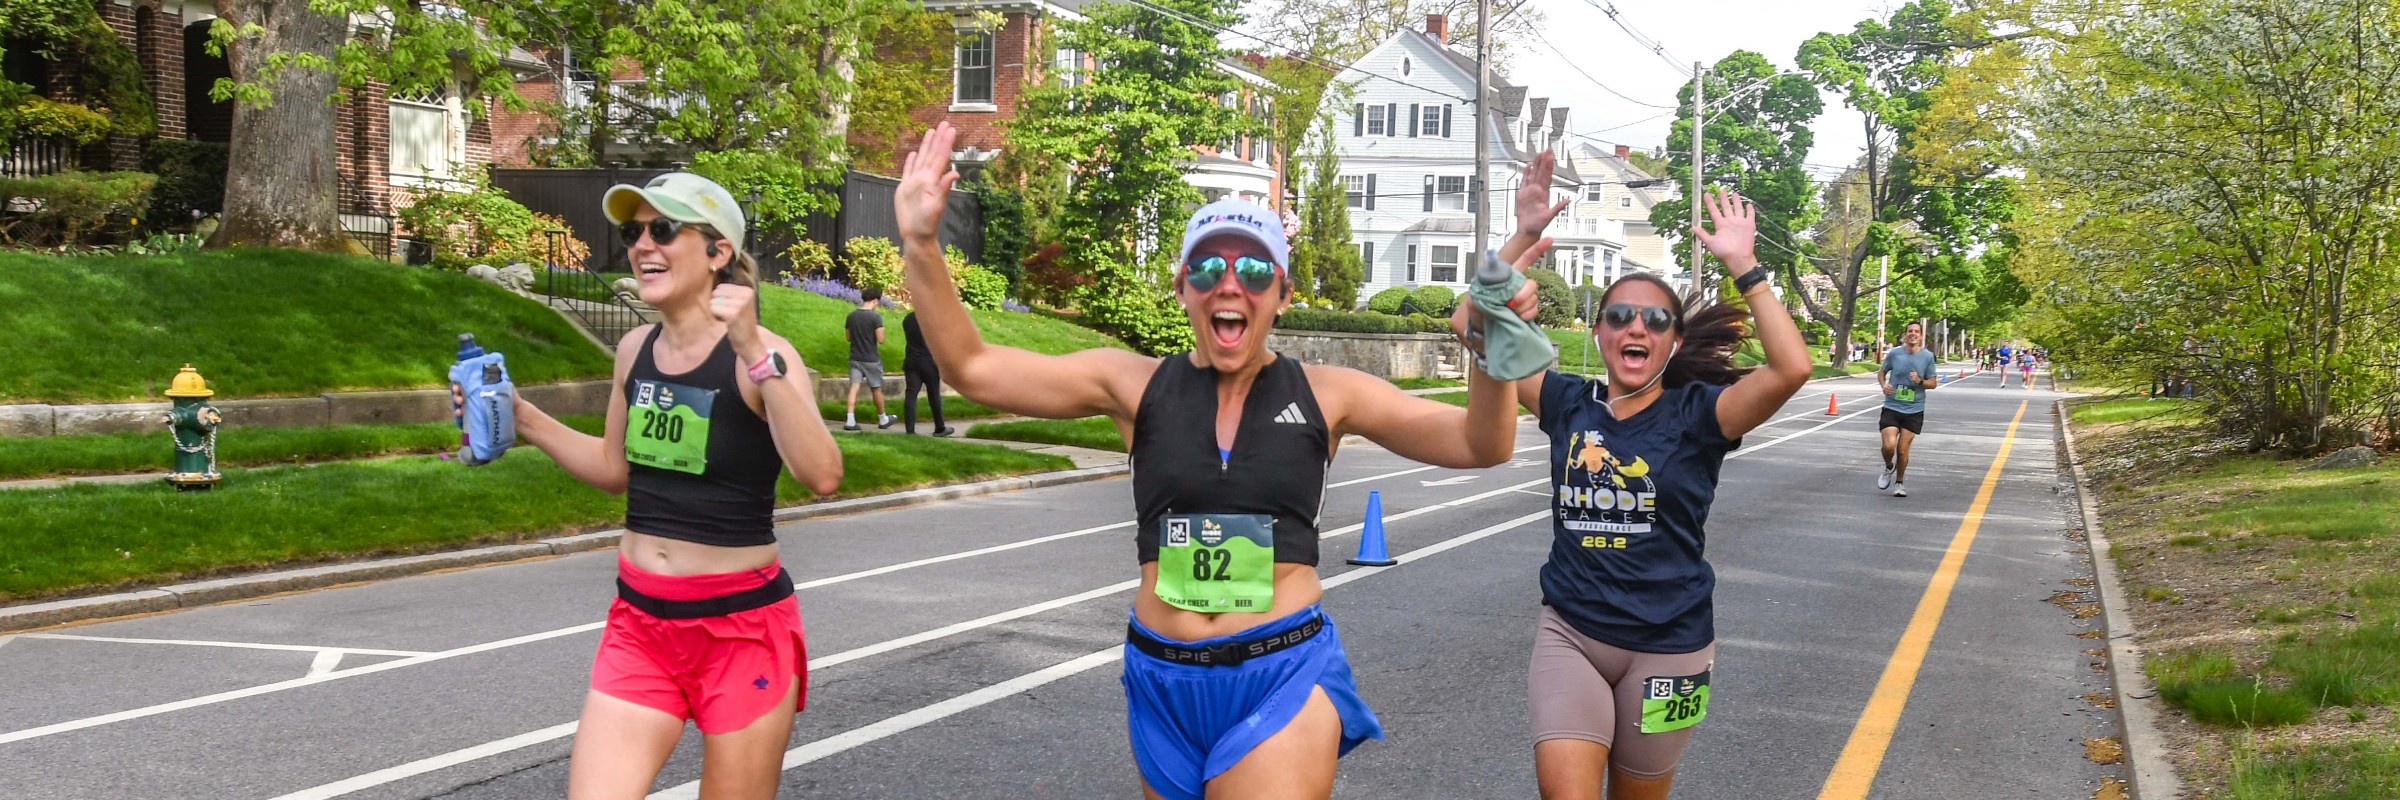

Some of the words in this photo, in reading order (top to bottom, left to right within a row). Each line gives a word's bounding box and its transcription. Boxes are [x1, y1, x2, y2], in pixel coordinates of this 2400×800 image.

[490, 400, 500, 446] NATHAN
[641, 409, 684, 444] 280
[1560, 484, 1657, 513] RHODE
[1560, 508, 1656, 523] RACES
[1578, 522, 1632, 533] PROVIDENCE
[1581, 535, 1627, 549] 26.2
[1193, 548, 1232, 582] 82
[1187, 599, 1209, 607] CHECK
[1234, 599, 1253, 608] BEER
[1663, 694, 1702, 723] 263
